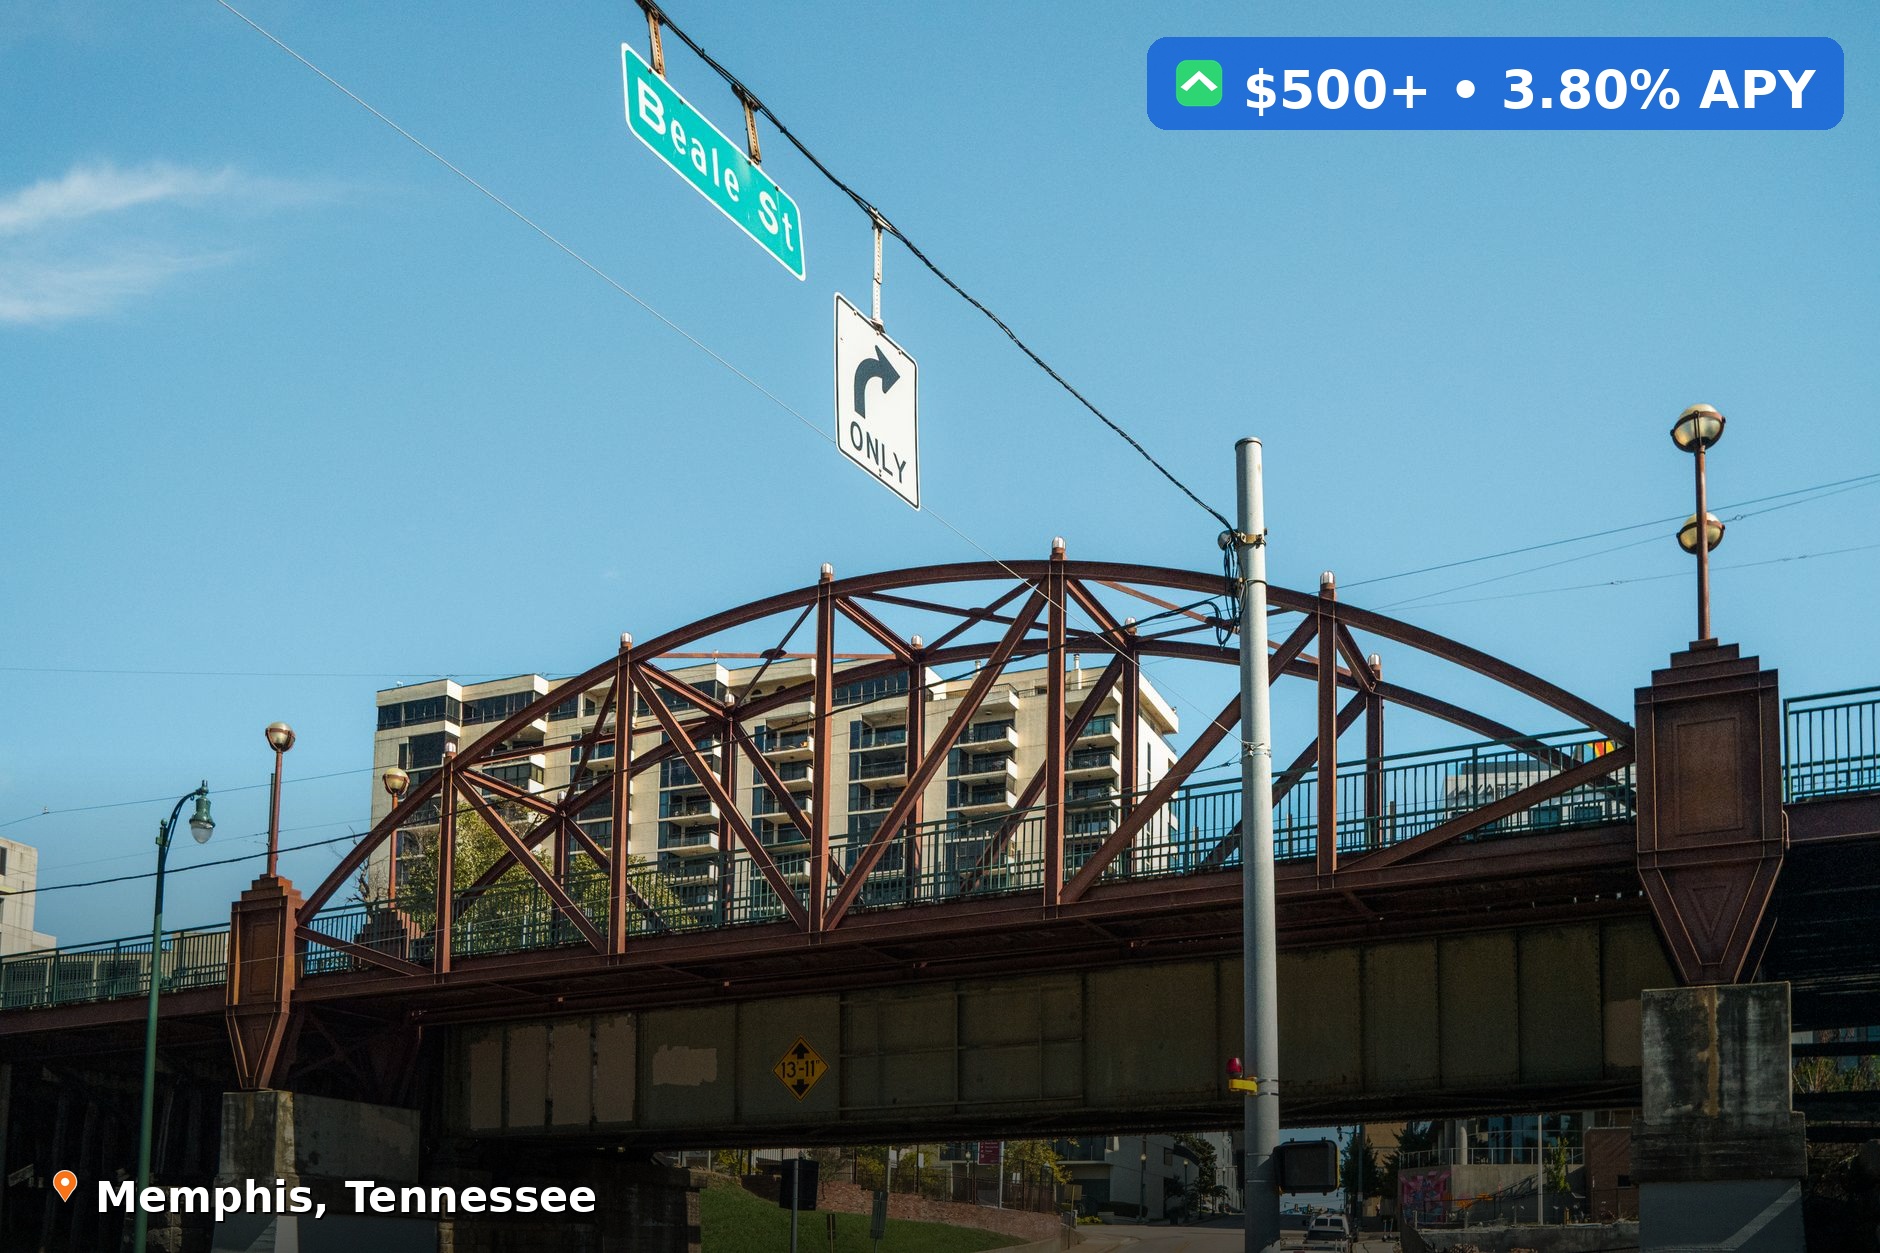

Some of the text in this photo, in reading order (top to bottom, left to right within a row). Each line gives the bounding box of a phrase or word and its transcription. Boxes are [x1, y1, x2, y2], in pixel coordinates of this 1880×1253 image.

[637, 76, 794, 252] Beale St
[850, 420, 907, 484] ONLY
